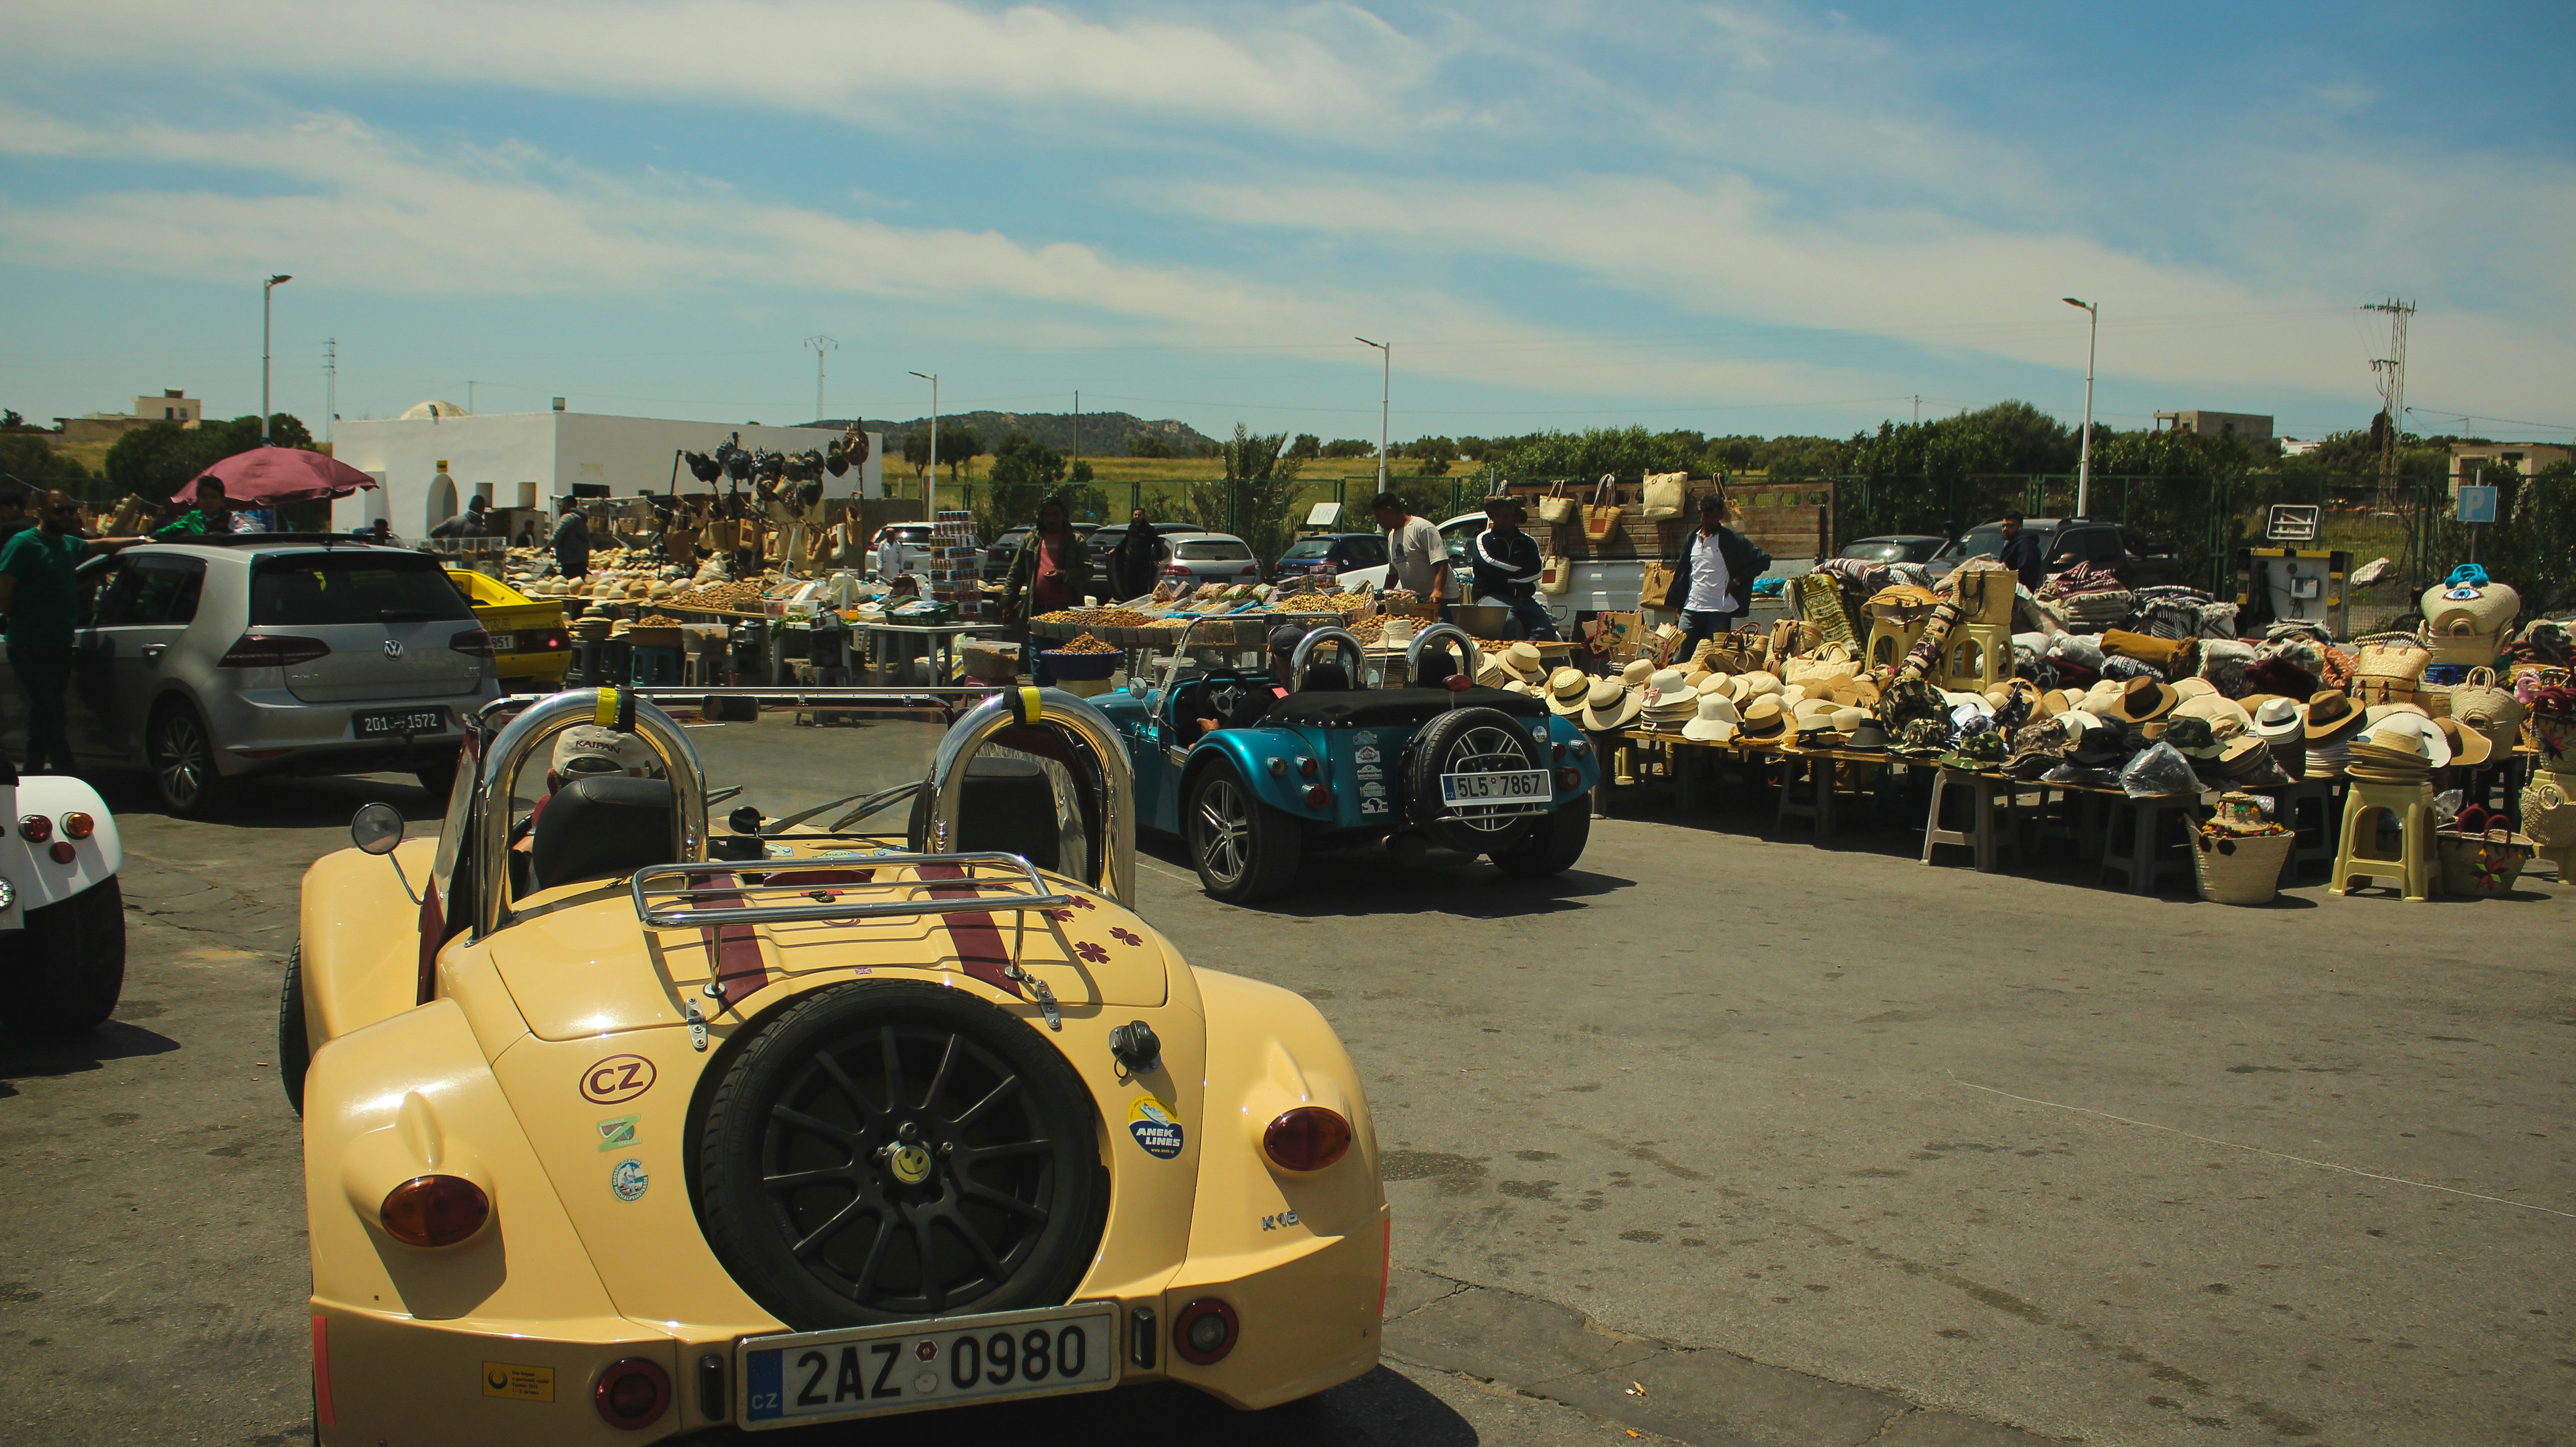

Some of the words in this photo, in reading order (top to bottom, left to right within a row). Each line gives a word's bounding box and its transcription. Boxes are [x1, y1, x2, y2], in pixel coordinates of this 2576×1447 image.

[2466, 489, 2485, 517] P
[364, 717, 389, 731] 201
[407, 714, 437, 728] 1572
[575, 740, 620, 754] KAIPAN
[1457, 777, 1489, 797] 5L5
[1500, 774, 1540, 795] 7867
[590, 1062, 644, 1095] CZ
[1136, 1127, 1174, 1137] ANEK
[1145, 1136, 1180, 1147] LINES
[797, 1343, 902, 1407] 2AZ
[950, 1325, 1086, 1389] 0980
[751, 1392, 777, 1411] CZ
